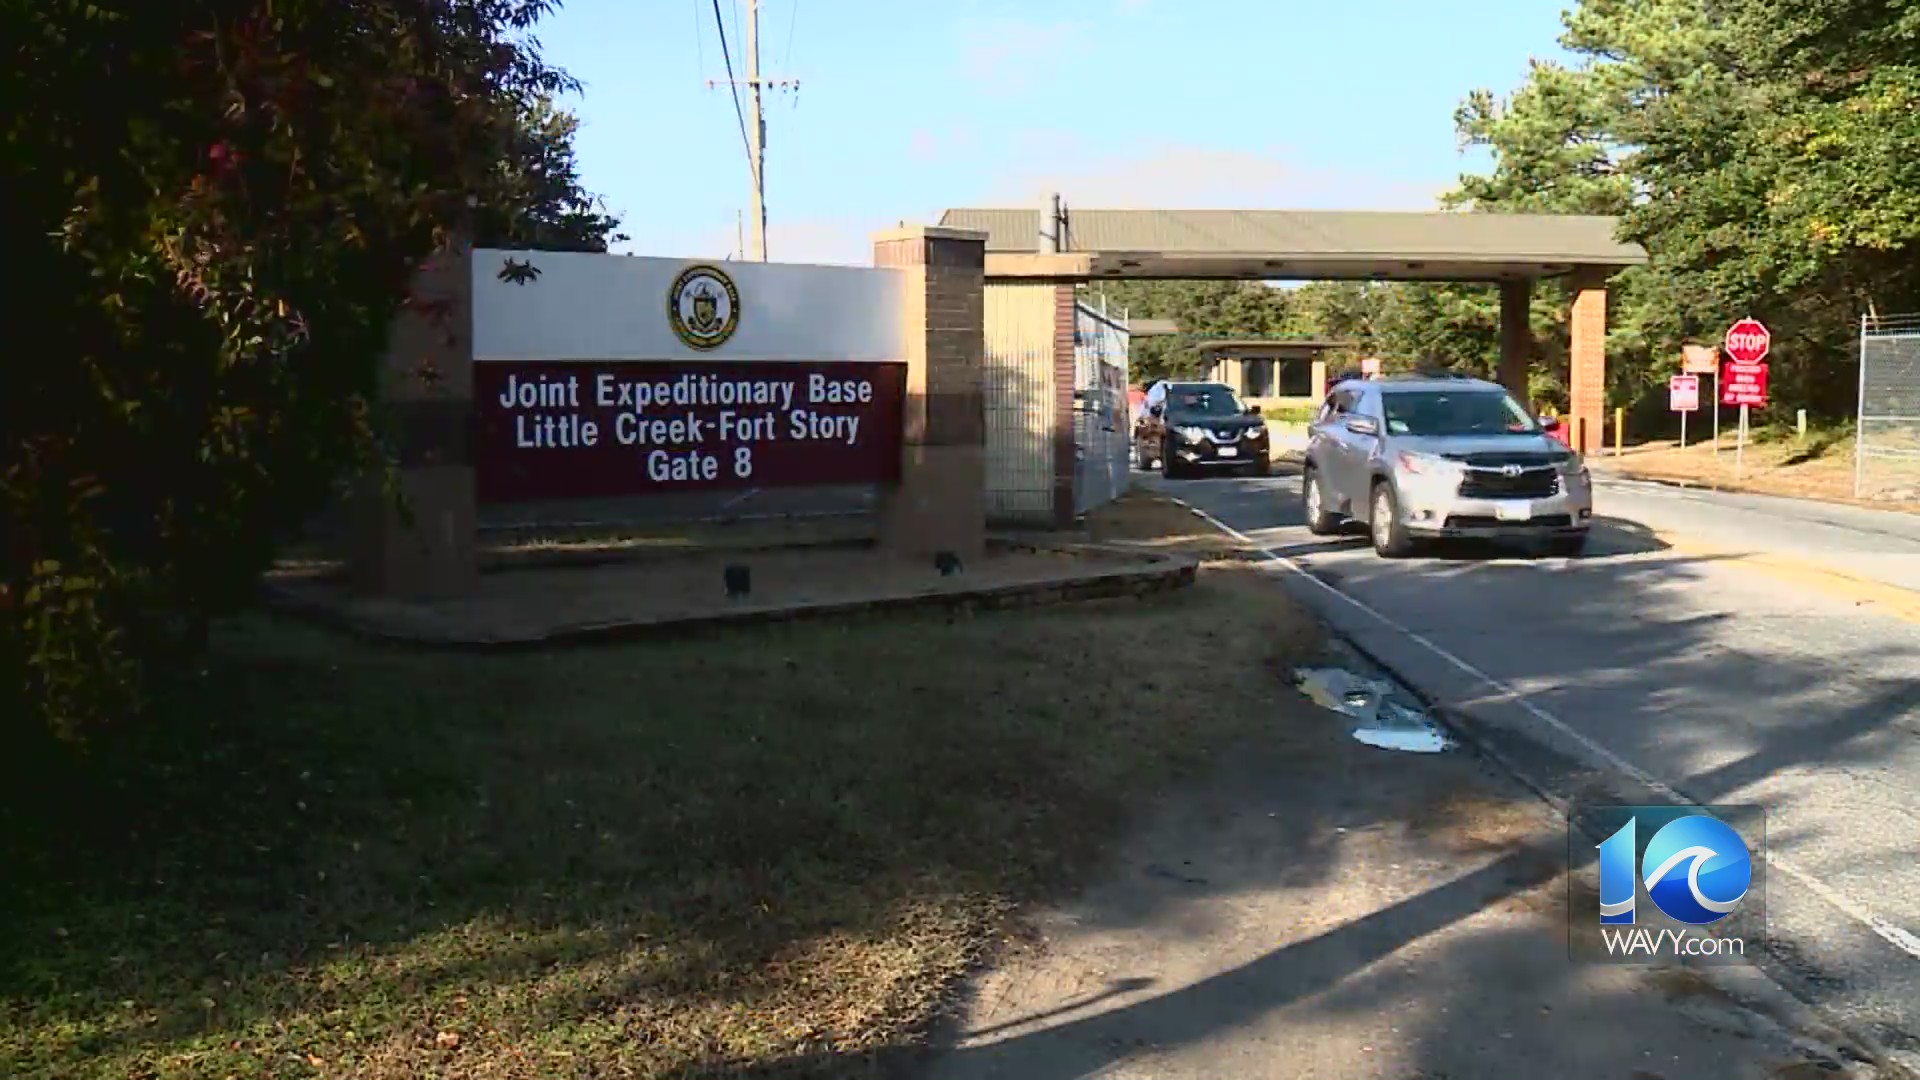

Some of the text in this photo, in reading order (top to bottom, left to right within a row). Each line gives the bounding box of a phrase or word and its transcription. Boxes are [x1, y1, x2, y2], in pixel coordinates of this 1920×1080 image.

[1729, 333, 1766, 351] STOP
[500, 373, 873, 413] Joint Expeditionary Base
[516, 409, 860, 448] Little Creek-Fort Story
[647, 448, 753, 482] Gate 8
